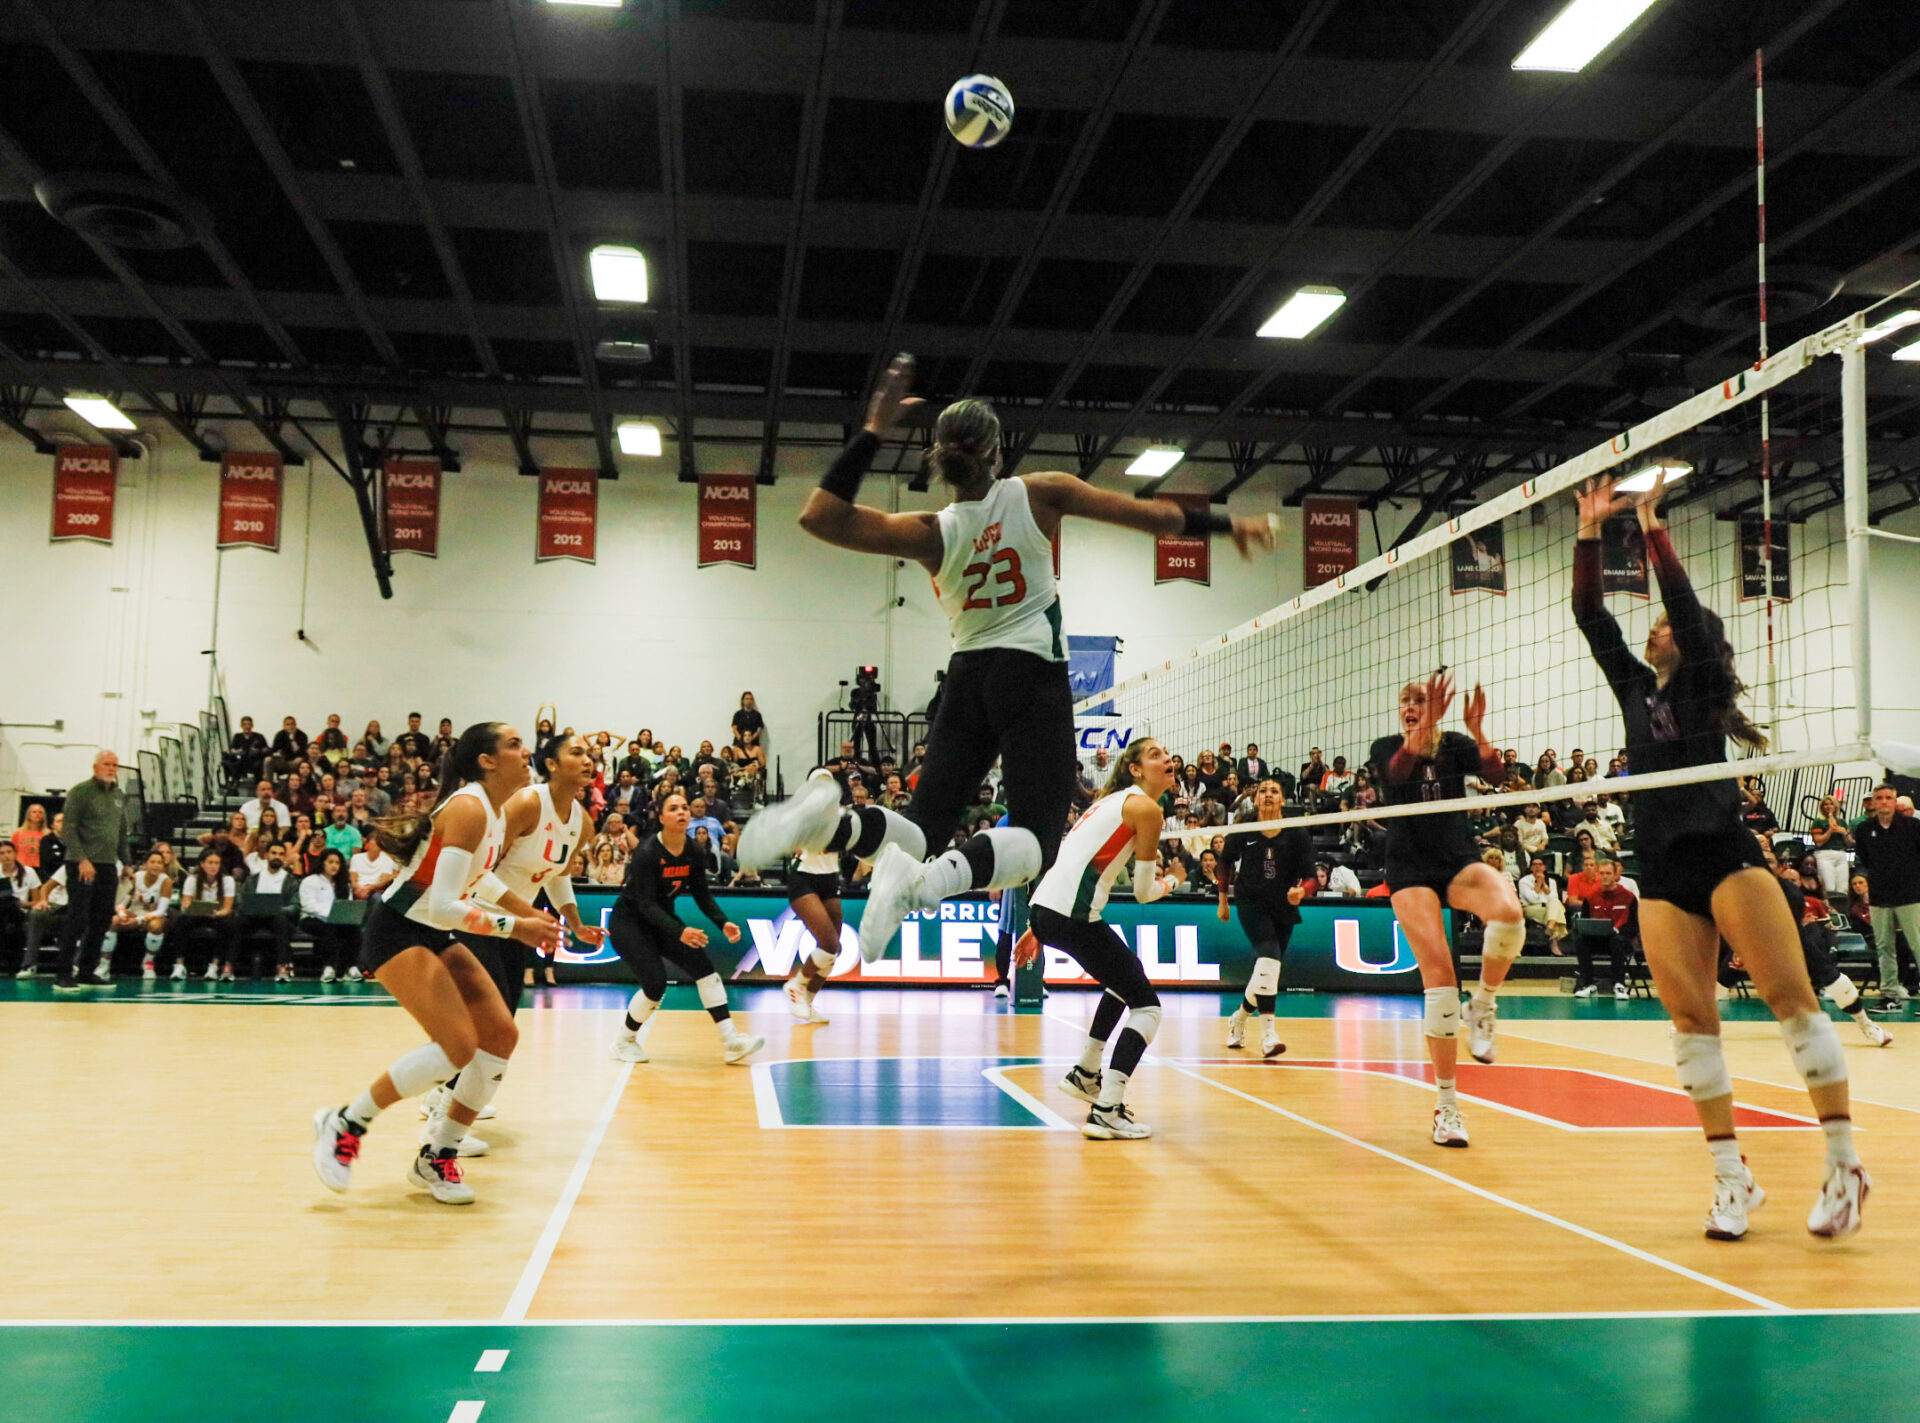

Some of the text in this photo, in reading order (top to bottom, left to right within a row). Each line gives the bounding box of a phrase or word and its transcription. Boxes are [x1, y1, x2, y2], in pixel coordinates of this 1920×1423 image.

[62, 457, 111, 473] NCAA
[227, 465, 275, 481] NCAA
[387, 473, 434, 489] NCAA
[545, 480, 592, 495] NCAA
[704, 485, 750, 501] NCAA
[67, 513, 100, 525] 2009
[233, 520, 264, 532] 2010
[1310, 512, 1351, 527] NCAA
[393, 528, 422, 539] 2011
[553, 533, 582, 546] 2012
[713, 539, 742, 551] 2013
[1168, 557, 1196, 568] 2015
[1317, 563, 1345, 575] 2017
[962, 547, 1027, 612] 23
[1075, 728, 1132, 749] CN
[542, 839, 569, 865] U
[1263, 860, 1276, 879] 5
[1333, 919, 1419, 975] U
